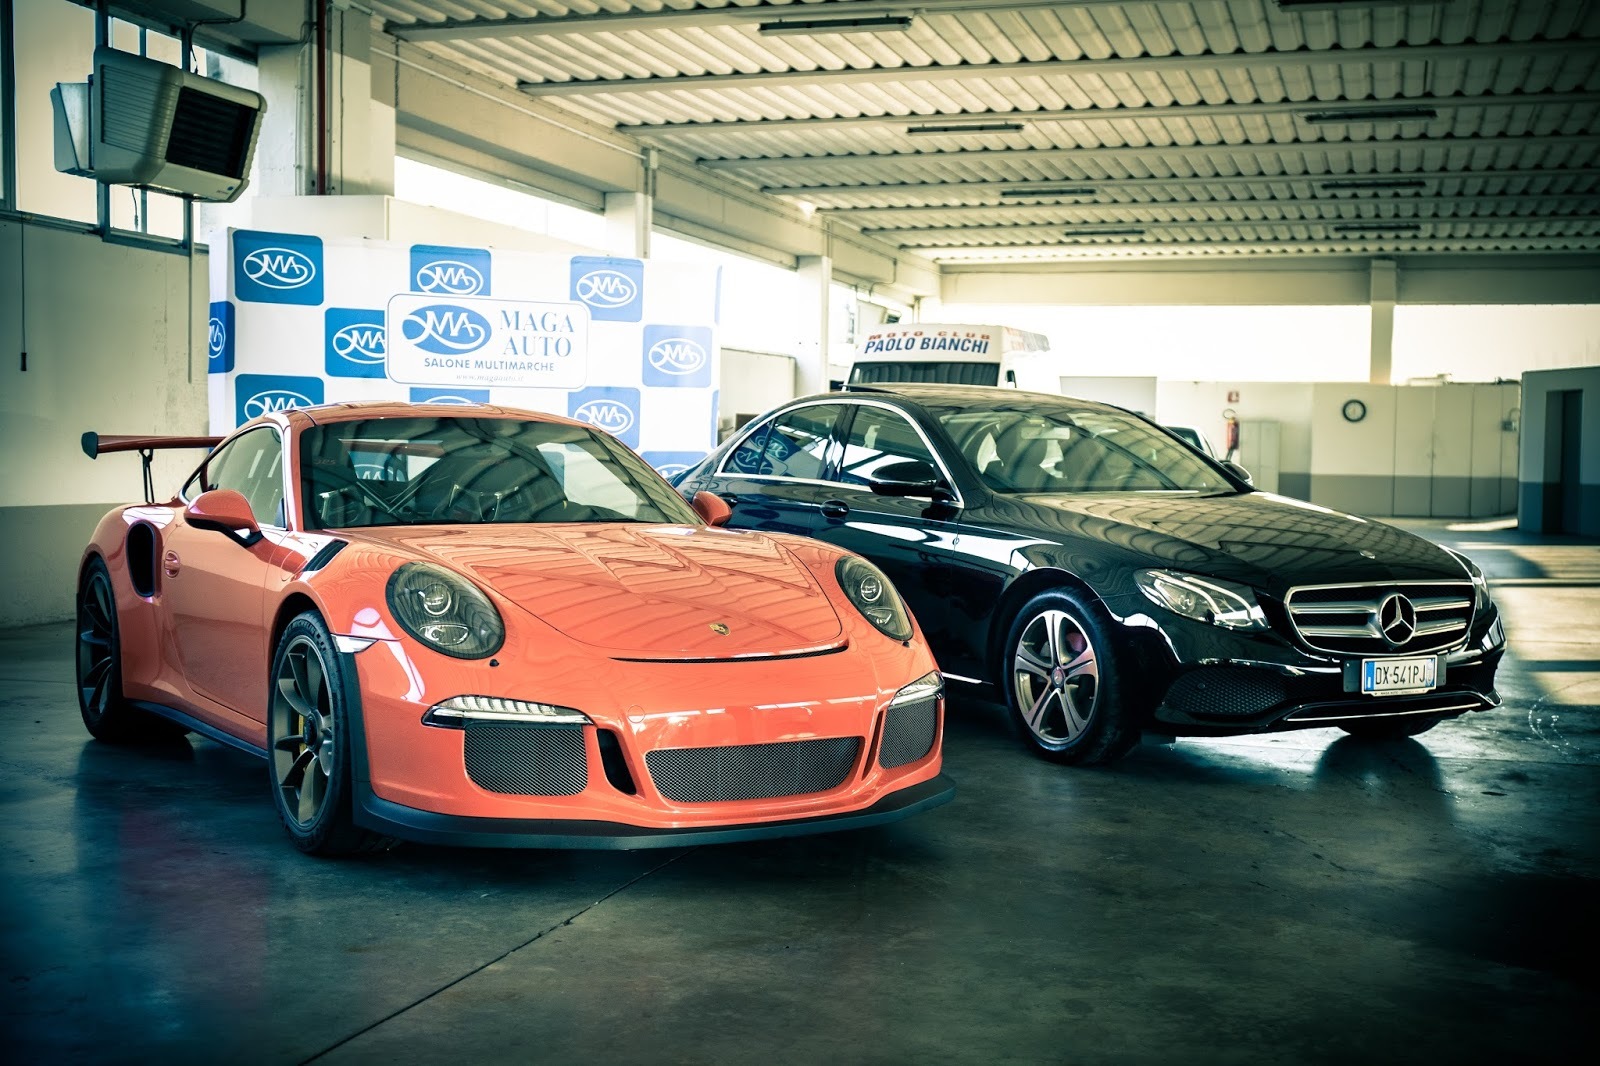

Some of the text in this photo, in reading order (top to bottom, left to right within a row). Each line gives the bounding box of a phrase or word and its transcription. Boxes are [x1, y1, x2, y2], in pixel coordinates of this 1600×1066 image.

[500, 309, 575, 333] MAGA
[868, 330, 991, 340] MOTO CLUB
[503, 336, 572, 358] AUTO
[864, 337, 916, 354] PAOLO
[920, 337, 989, 354] BIANCHI
[424, 357, 555, 372] SALONE MULTIMARCHE
